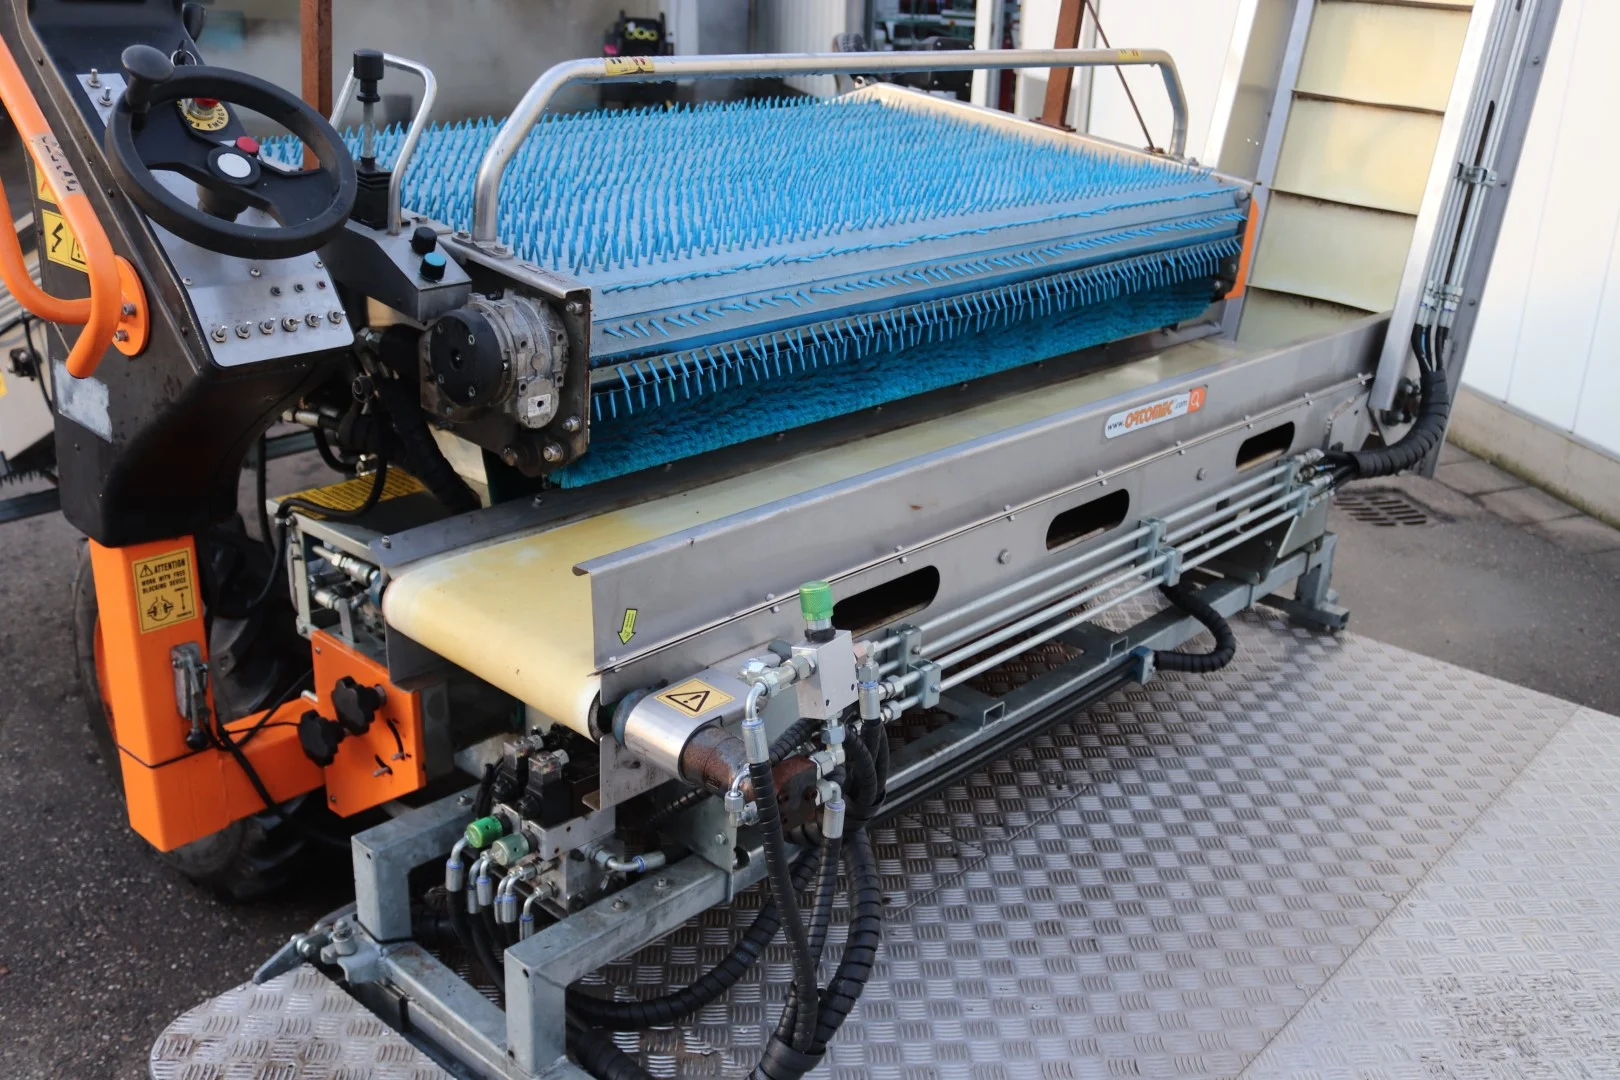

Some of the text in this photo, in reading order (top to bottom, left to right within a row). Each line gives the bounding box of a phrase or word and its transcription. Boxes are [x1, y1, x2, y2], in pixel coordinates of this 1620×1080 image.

[154, 559, 186, 573] ATTENTION
[142, 578, 156, 586] WORK
[143, 584, 166, 594] BLOCKING
[170, 578, 186, 586] DEVICE
